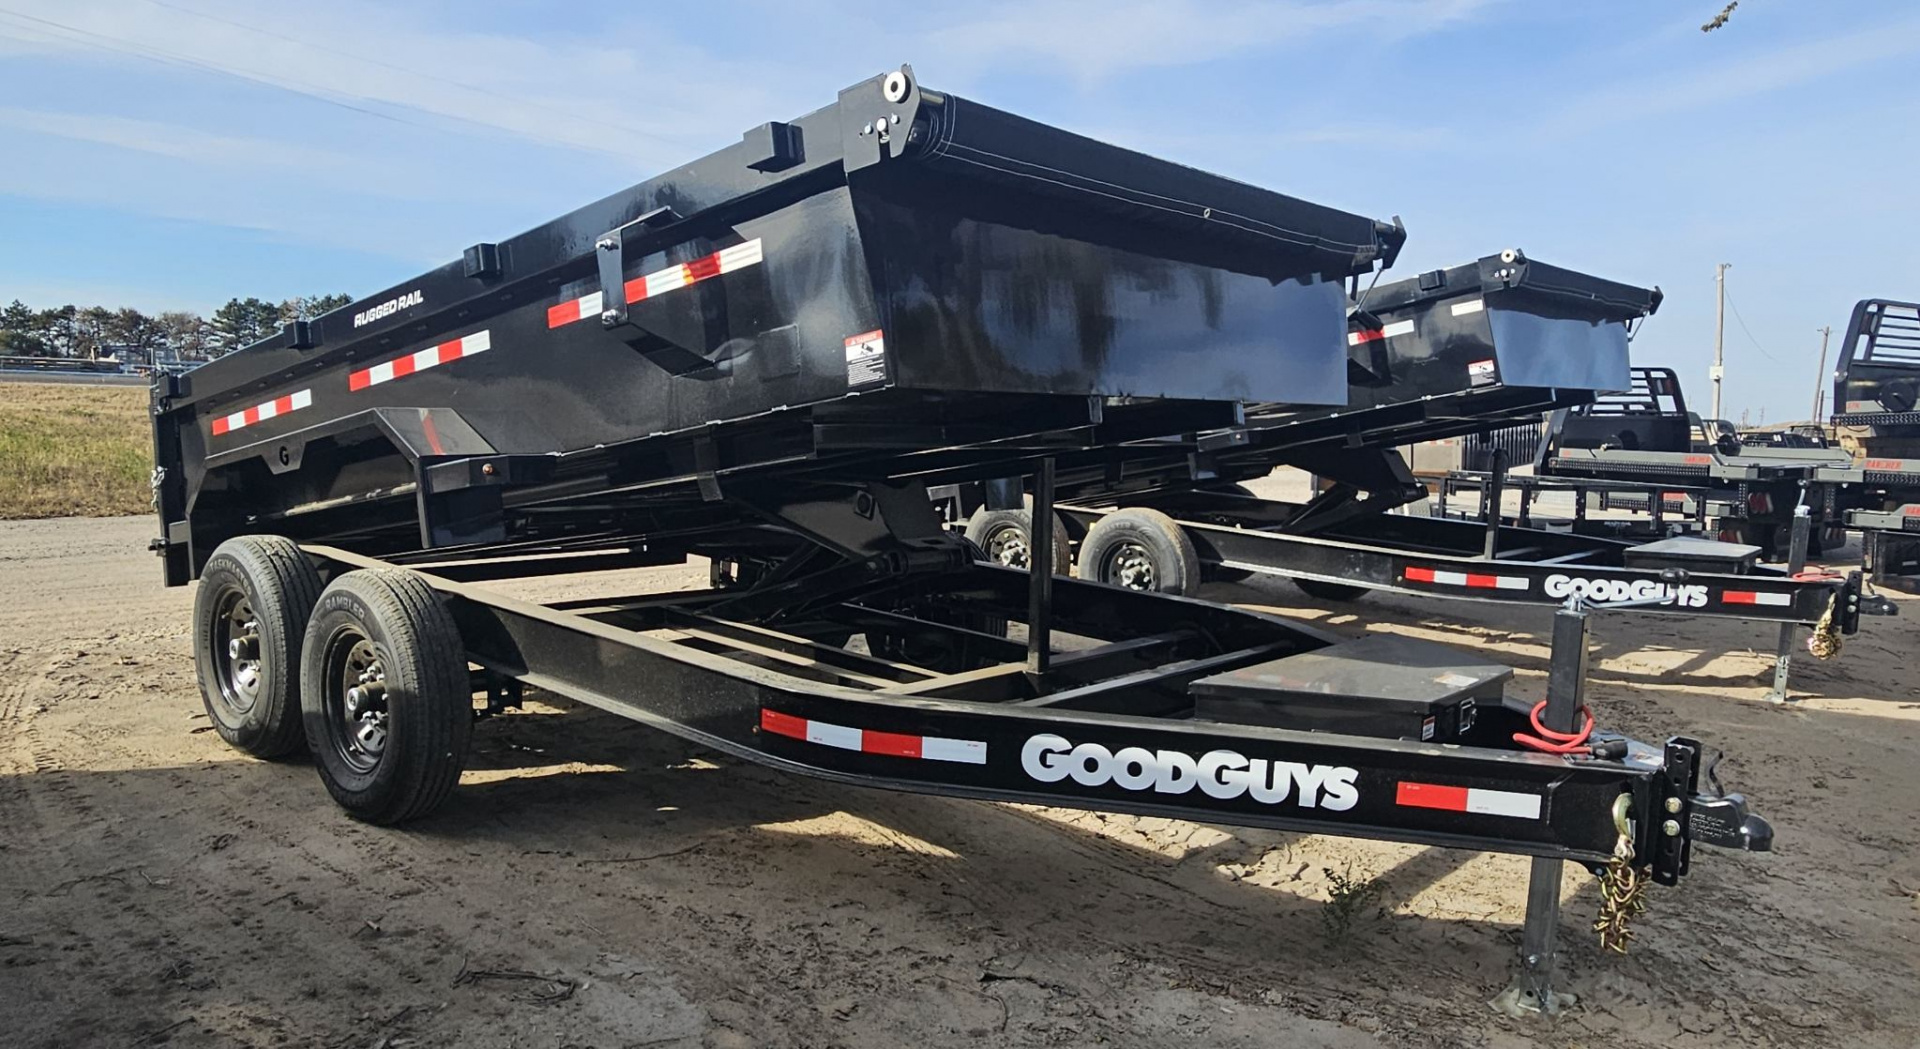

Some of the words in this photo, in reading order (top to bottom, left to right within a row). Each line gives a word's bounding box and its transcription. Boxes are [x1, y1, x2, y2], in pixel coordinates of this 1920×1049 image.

[354, 298, 398, 328] RUGGED
[398, 289, 424, 311] RAIL
[279, 446, 289, 466] G
[1544, 574, 1708, 607] GOODGUYS
[325, 595, 365, 621] RAMBLER
[1021, 733, 1360, 812] GOODGUYS
